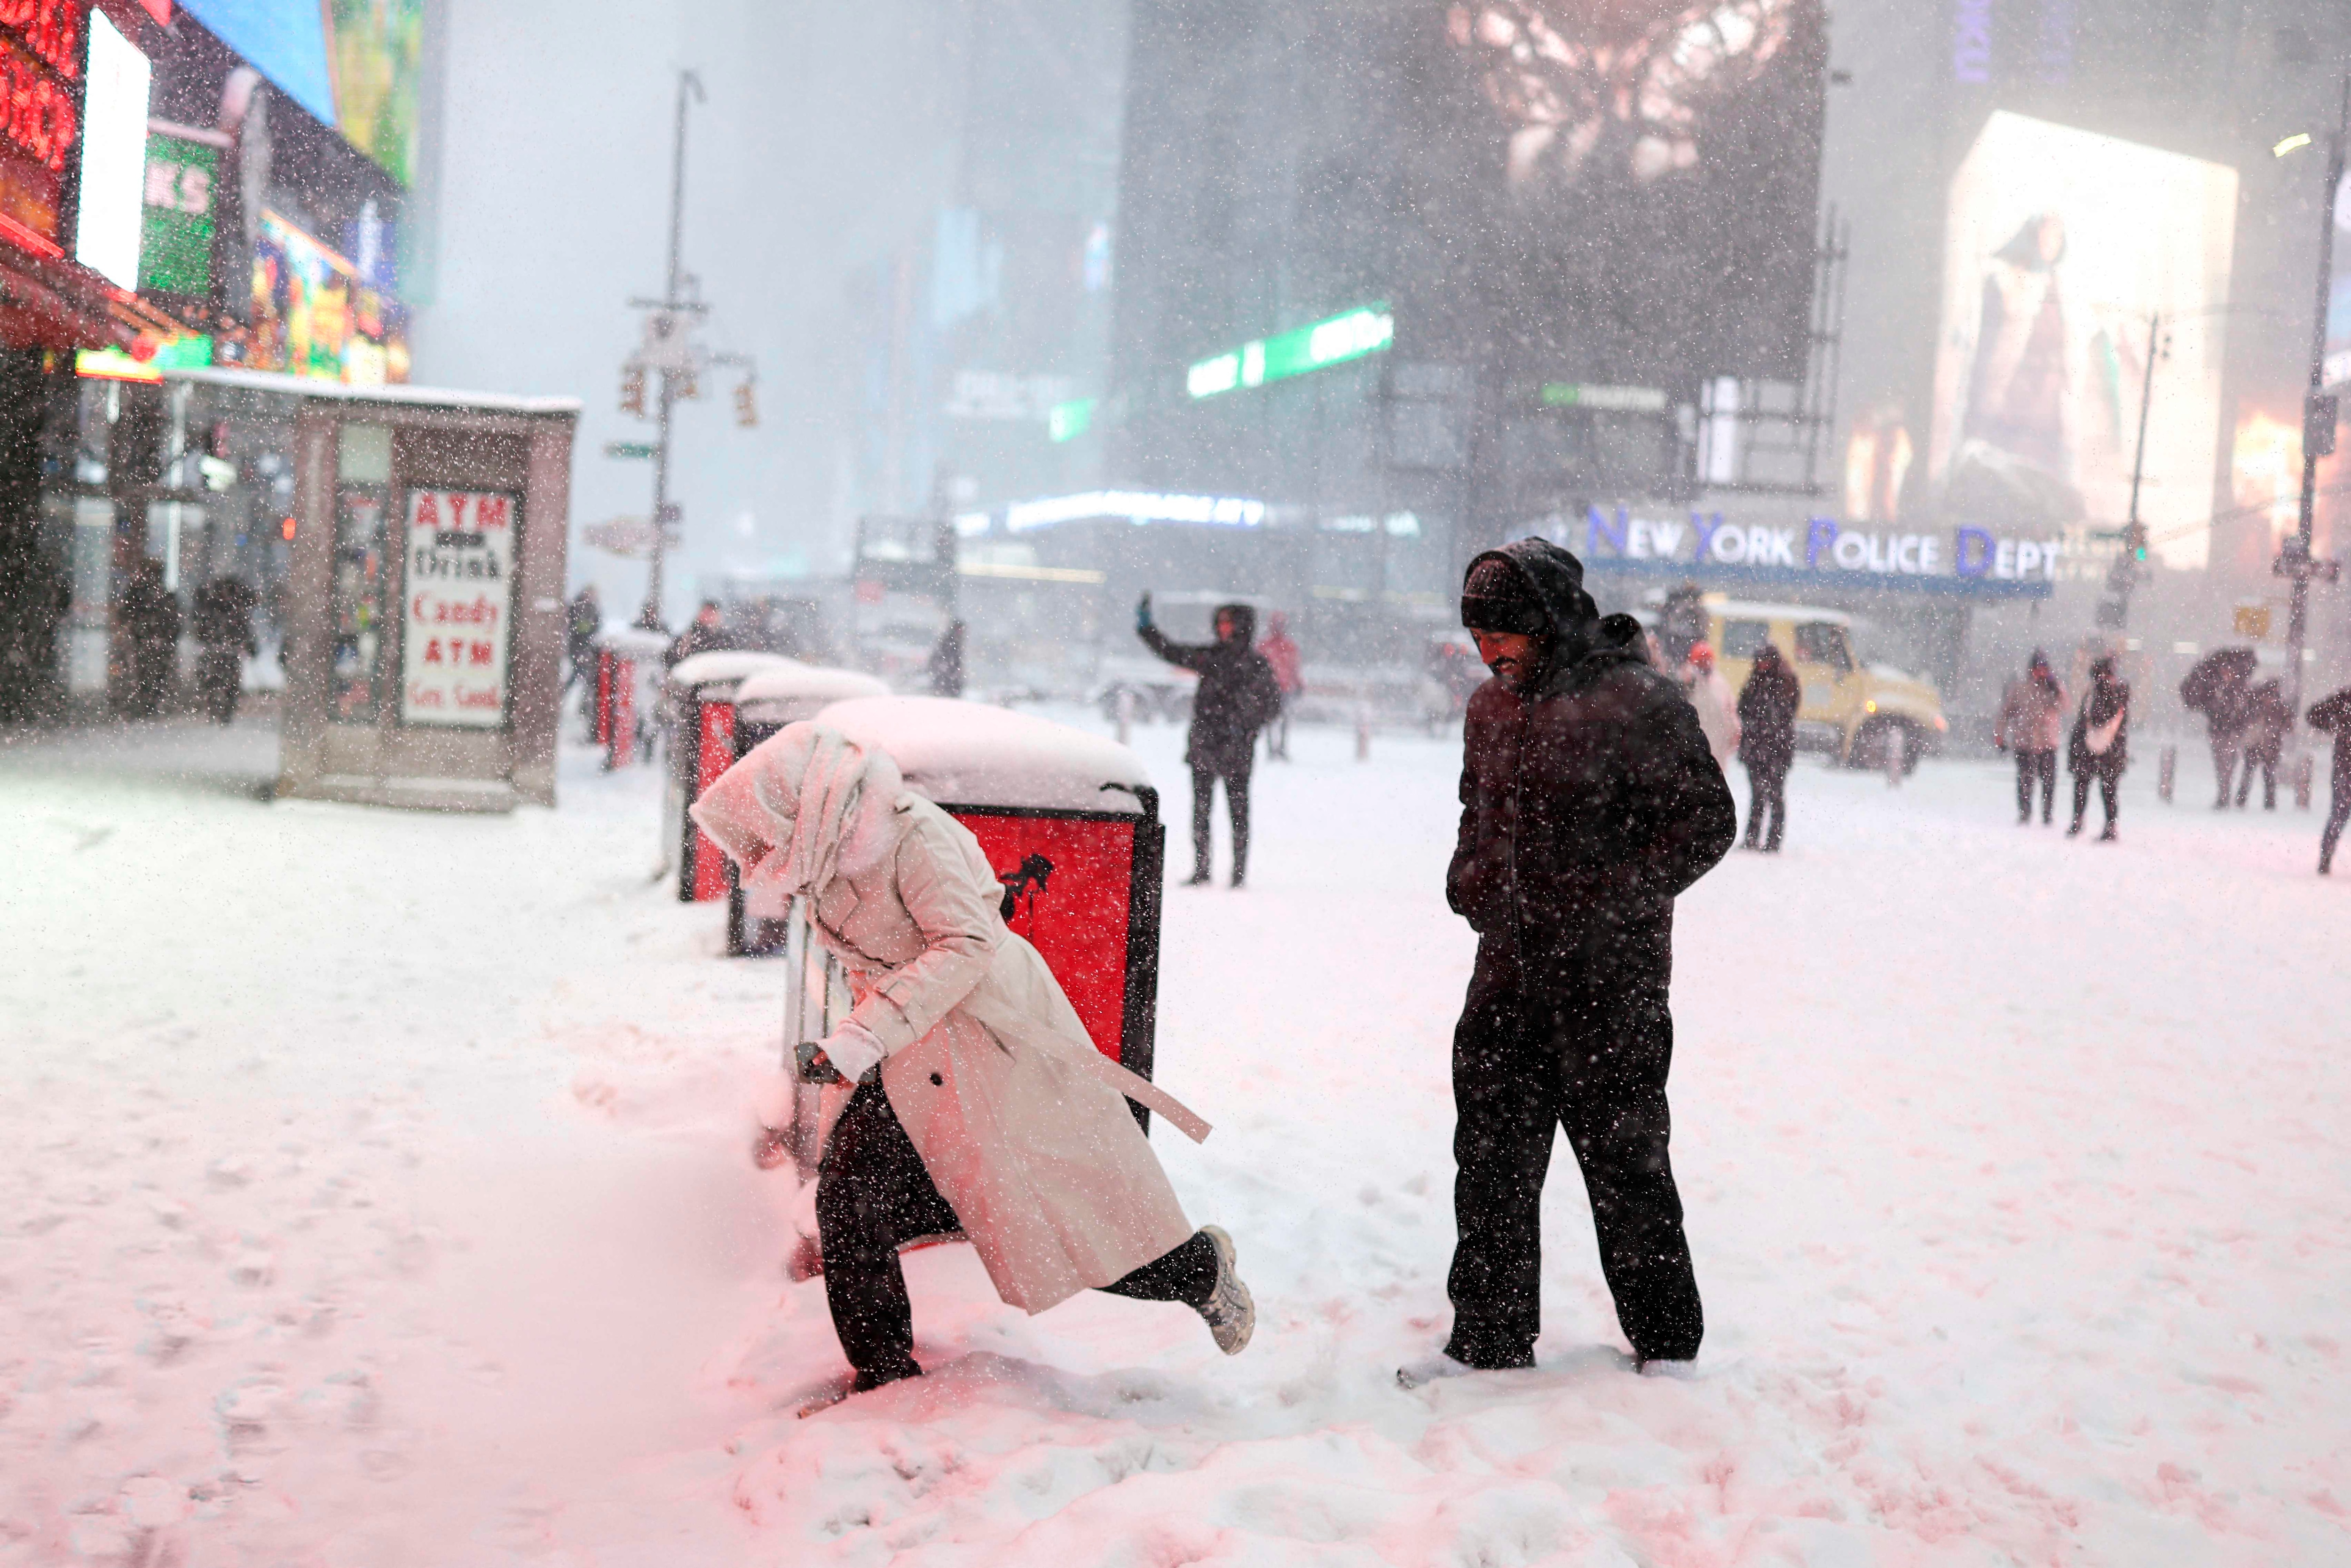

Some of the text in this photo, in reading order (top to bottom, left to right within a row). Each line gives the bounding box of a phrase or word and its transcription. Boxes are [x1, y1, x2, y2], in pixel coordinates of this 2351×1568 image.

[1586, 504, 1686, 559] NEW
[1691, 510, 1796, 566] YORK
[1807, 516, 1939, 575] POLICE
[1956, 524, 2060, 581] DEPT
[412, 591, 497, 636] Candy
[425, 638, 494, 666] ATM
